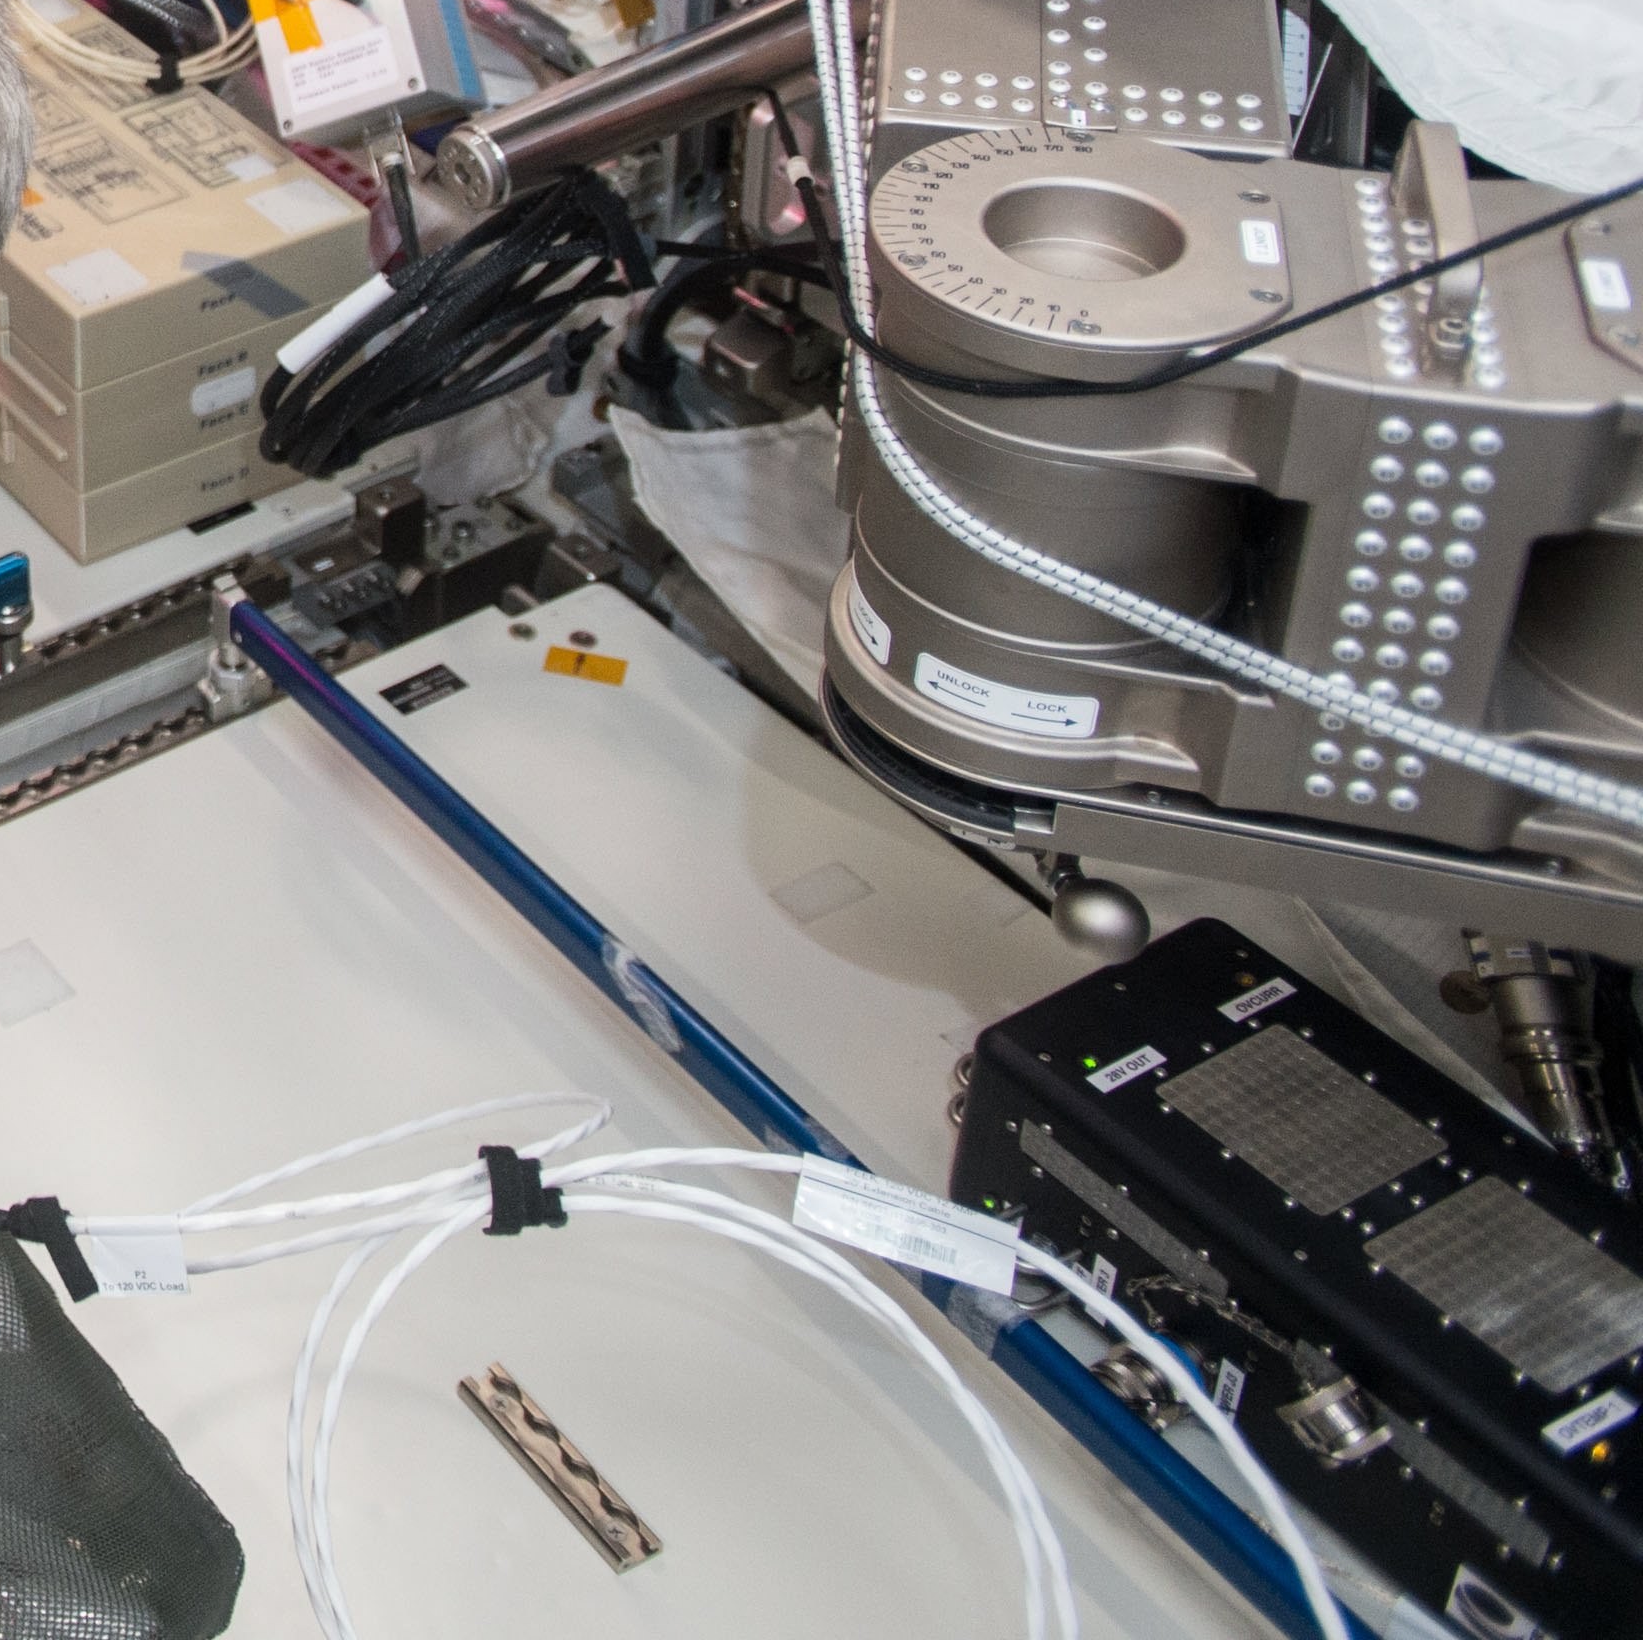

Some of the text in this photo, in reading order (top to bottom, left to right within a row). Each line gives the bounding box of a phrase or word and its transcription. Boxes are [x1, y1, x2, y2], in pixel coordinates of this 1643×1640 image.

[1018, 145, 1037, 153] 160
[1044, 144, 1064, 152] 170
[1073, 145, 1093, 154] 180
[994, 148, 1014, 157] 150
[971, 154, 990, 162] 140
[934, 172, 953, 180] 120
[923, 182, 940, 190] 110
[914, 195, 933, 203] 100
[910, 208, 924, 216] 90
[912, 223, 927, 231] 80
[931, 251, 946, 259] 60
[948, 264, 963, 272] 50
[968, 277, 983, 285] 40
[992, 288, 1007, 296] 30
[1019, 297, 1034, 305] 20
[1047, 305, 1060, 313] 10
[201, 472, 234, 492] Face
[937, 669, 1067, 714] UNLOCK LOCK
[1236, 986, 1283, 1014] OVCURR
[1127, 1054, 1152, 1072] OUT
[863, 1183, 916, 1208] Extension
[919, 1201, 952, 1219] Cable
[134, 1270, 146, 1279] P2
[103, 1281, 185, 1291] To 120 VDC Load
